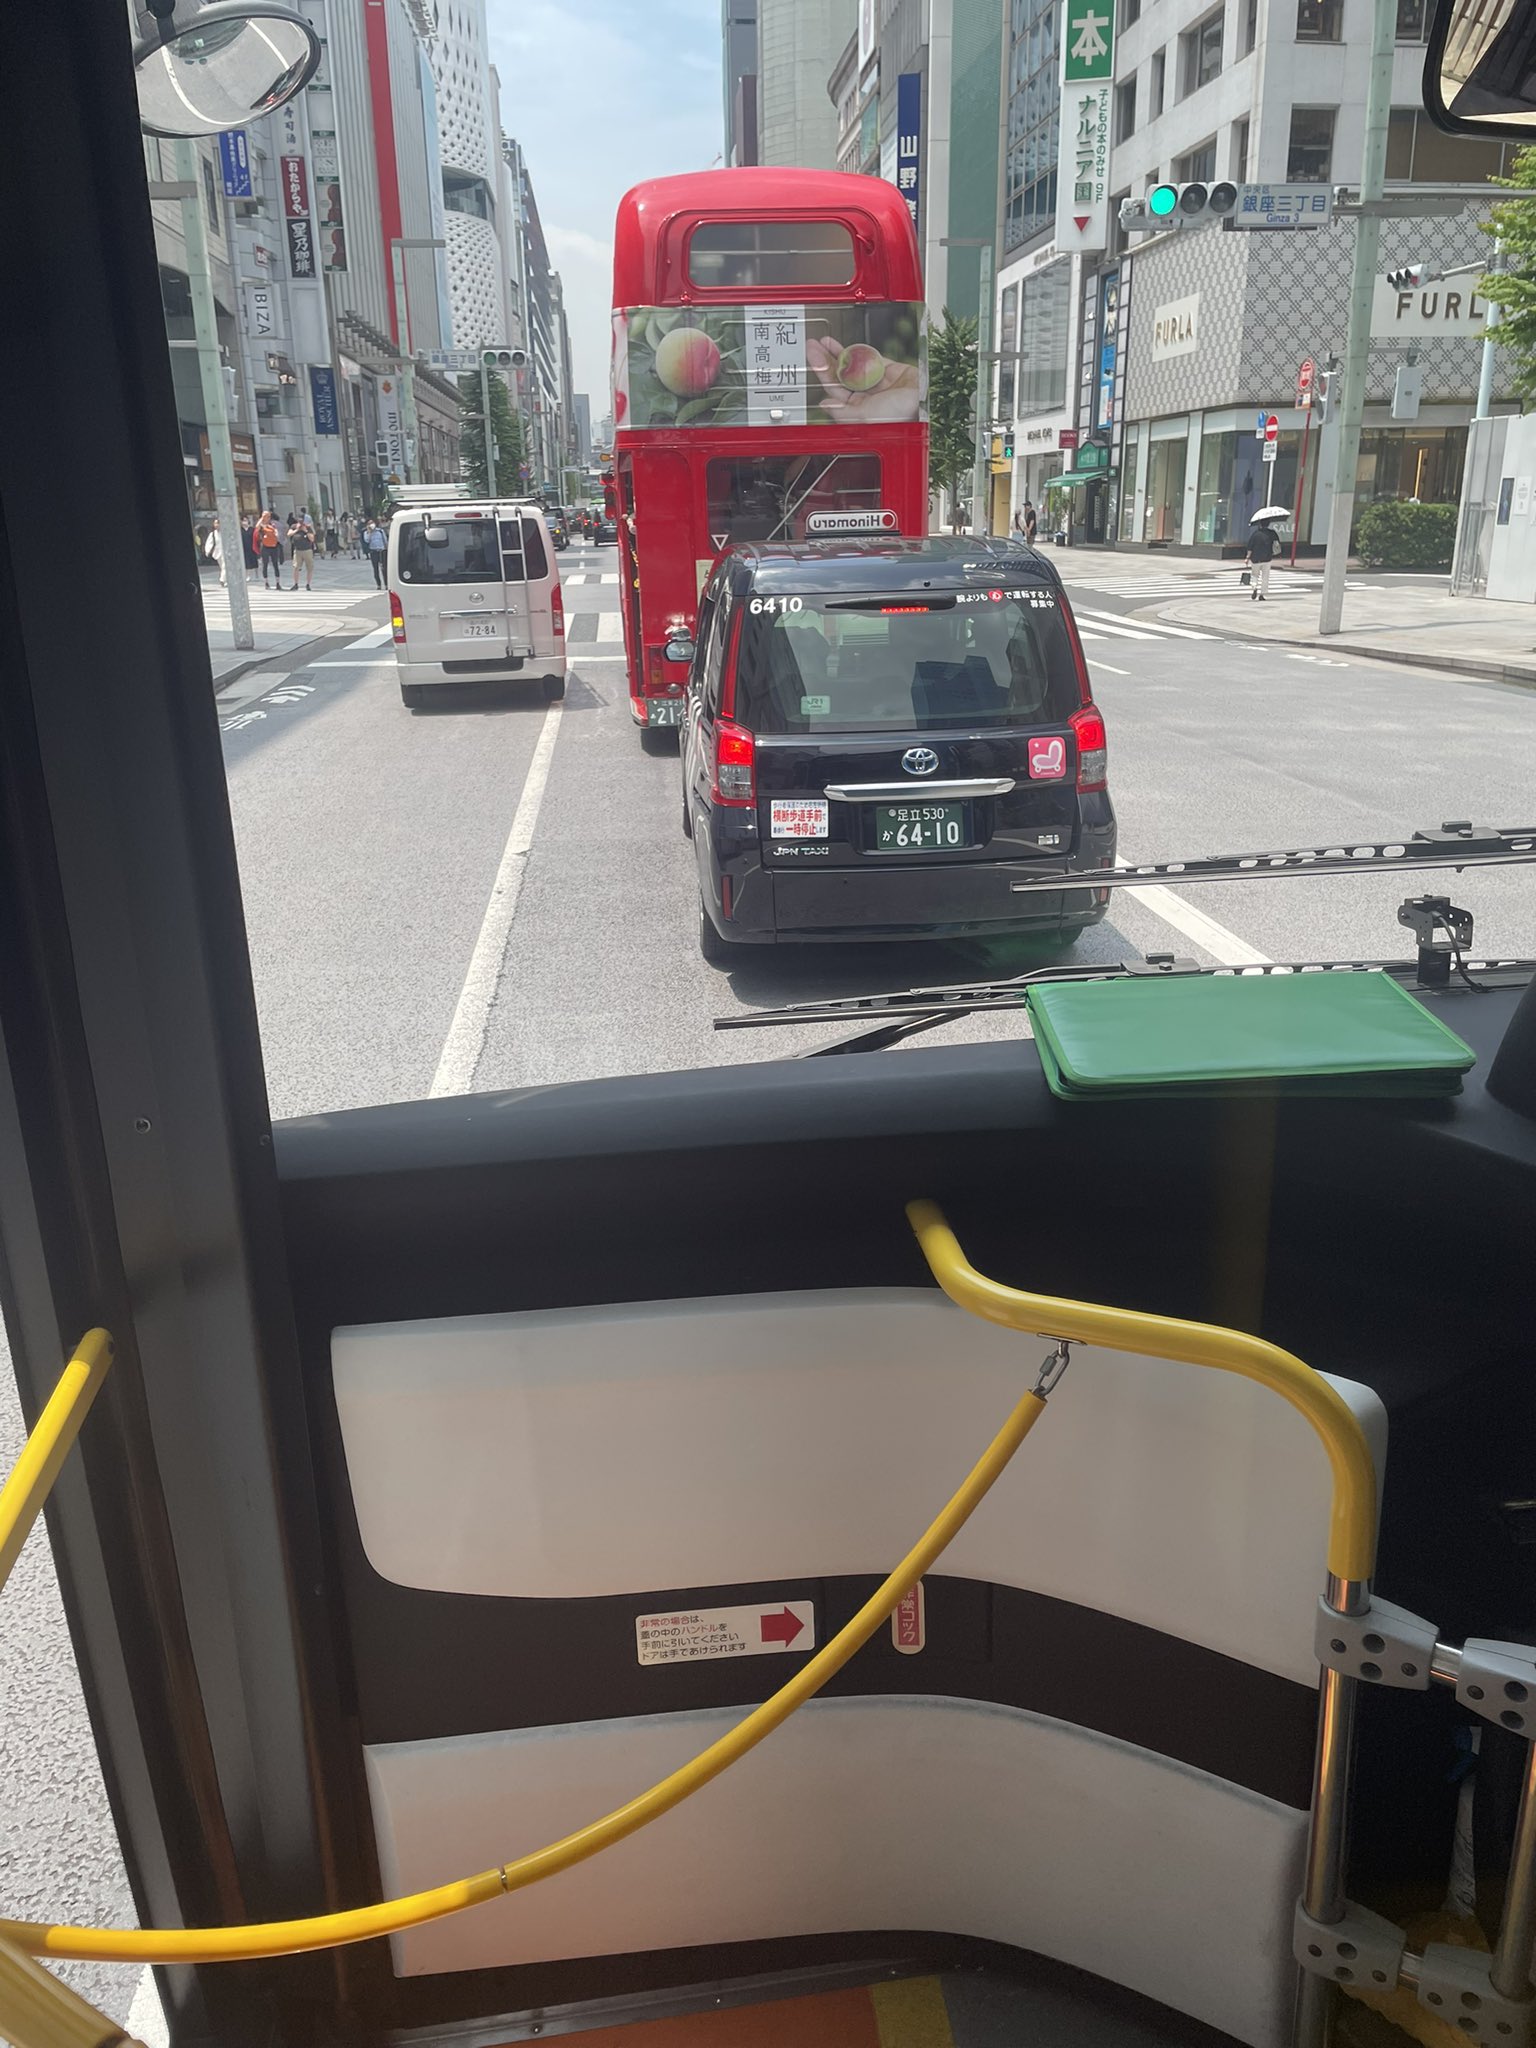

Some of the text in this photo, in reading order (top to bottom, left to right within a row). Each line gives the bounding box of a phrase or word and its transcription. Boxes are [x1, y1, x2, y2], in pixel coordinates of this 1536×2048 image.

[1071, 9, 1109, 66] 本
[1074, 95, 1097, 203] ナルニア国
[1241, 194, 1327, 212] 銀座三丁目
[1266, 213, 1300, 223] Ginza 3
[253, 286, 271, 335] IBIZA
[1396, 291, 1506, 320] FURL
[1155, 311, 1193, 349] FURLA
[753, 322, 772, 385] 南高梅
[776, 322, 798, 386] 紀州
[750, 597, 803, 615] 6410
[469, 625, 496, 636] 72-84
[897, 807, 945, 821] 足立 530
[882, 821, 959, 847] か 64-10
[773, 846, 829, 856] JPN TAXI
[640, 1622, 728, 1640] 蓋の中のハンドルを
[641, 1632, 740, 1651] 手前に引いてください
